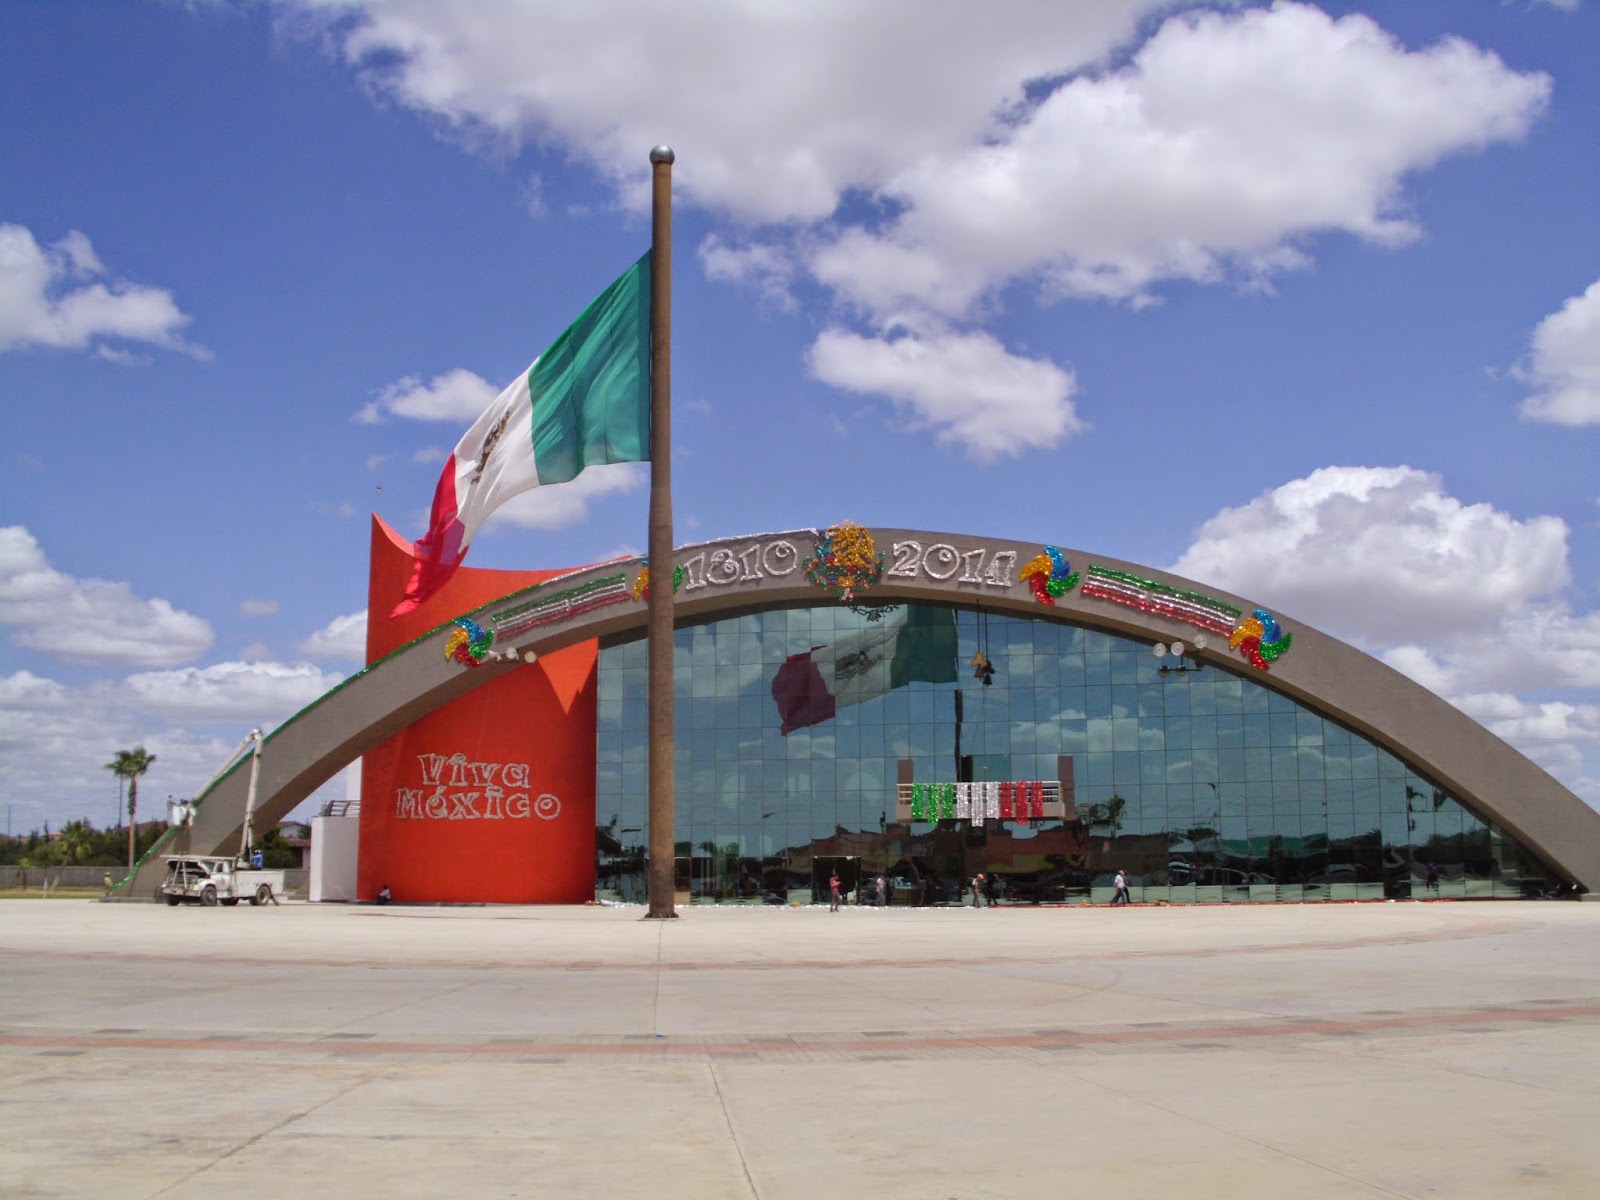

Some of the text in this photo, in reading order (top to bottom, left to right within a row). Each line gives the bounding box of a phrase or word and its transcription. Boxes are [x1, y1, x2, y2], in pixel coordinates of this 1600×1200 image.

[684, 541, 798, 590] 1810
[888, 541, 1017, 587] 2014
[417, 753, 531, 788] Viva
